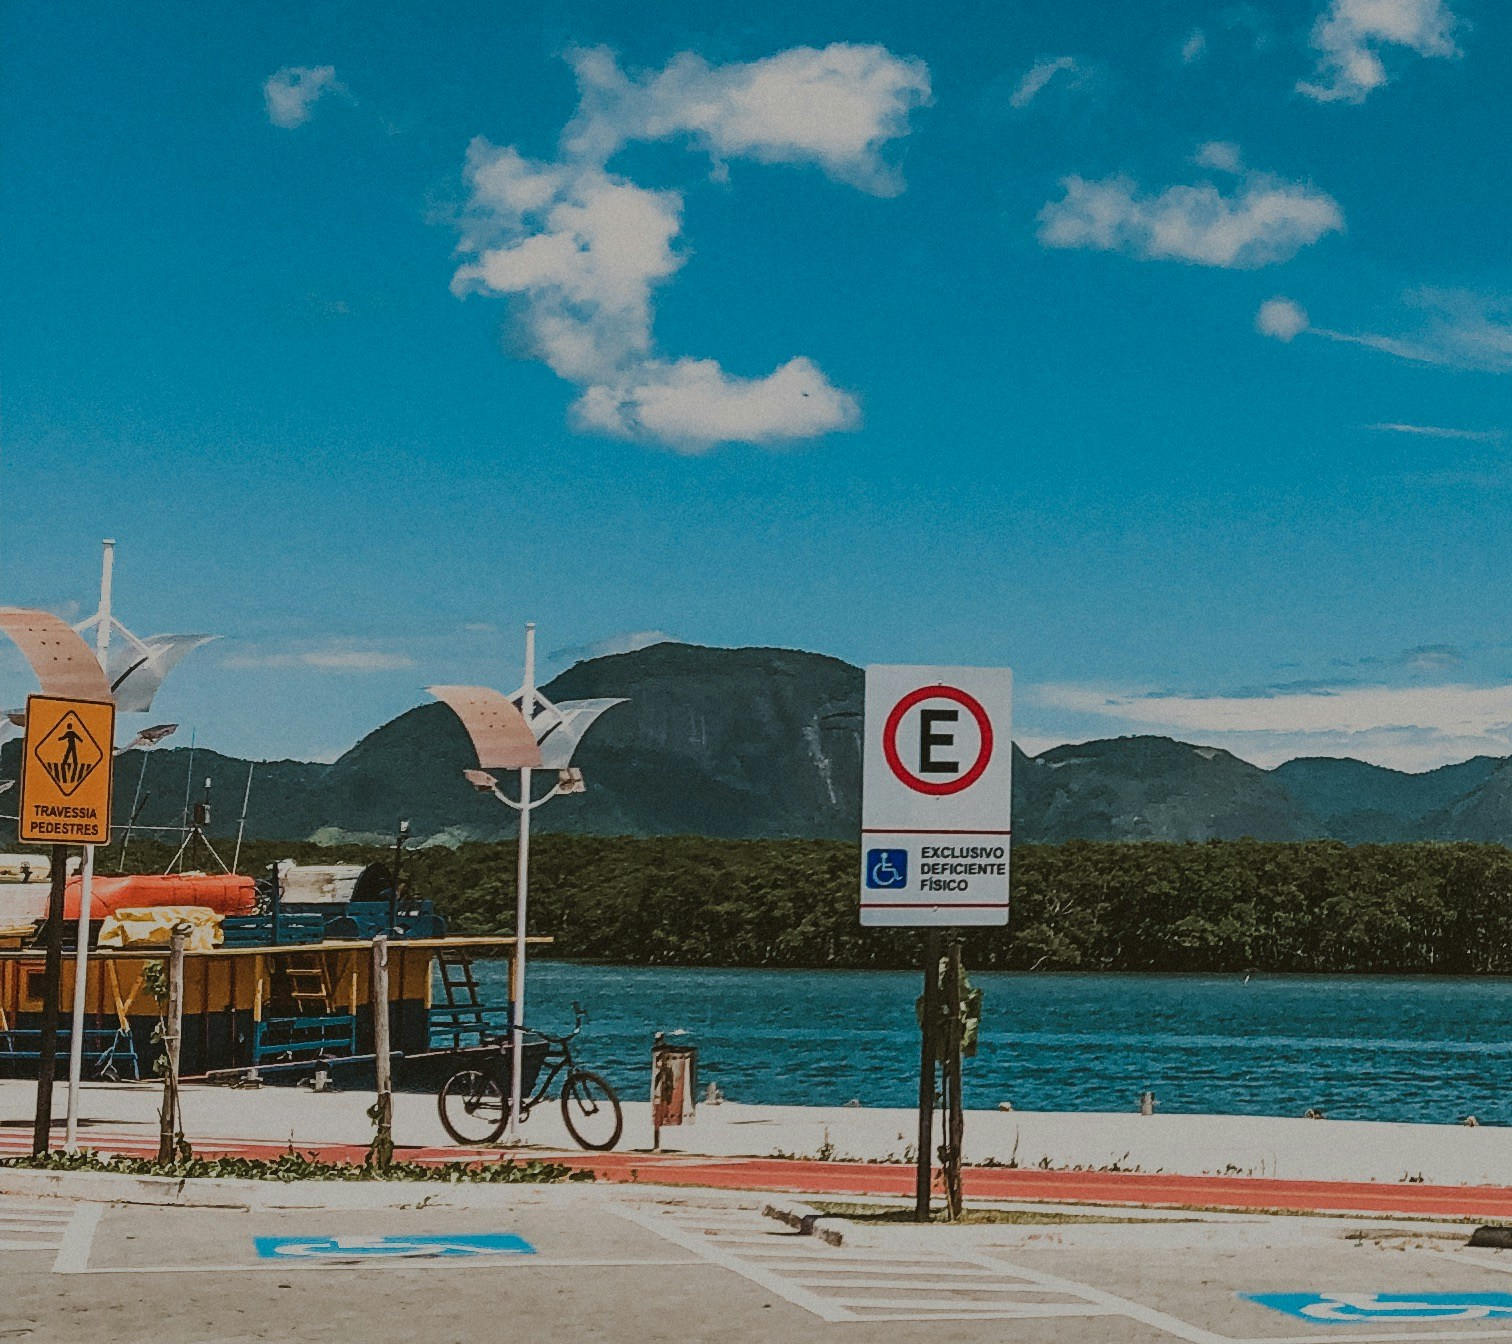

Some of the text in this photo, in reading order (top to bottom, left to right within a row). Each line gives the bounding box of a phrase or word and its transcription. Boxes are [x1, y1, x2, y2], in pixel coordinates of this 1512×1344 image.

[918, 709, 960, 774] E
[34, 804, 98, 820] TRAVESSIA
[30, 821, 99, 836] PEDESTRES
[921, 846, 1005, 860] EXCLUSIVO
[920, 862, 1006, 876] DEFICIENTE
[919, 876, 970, 892] FÍSICO
